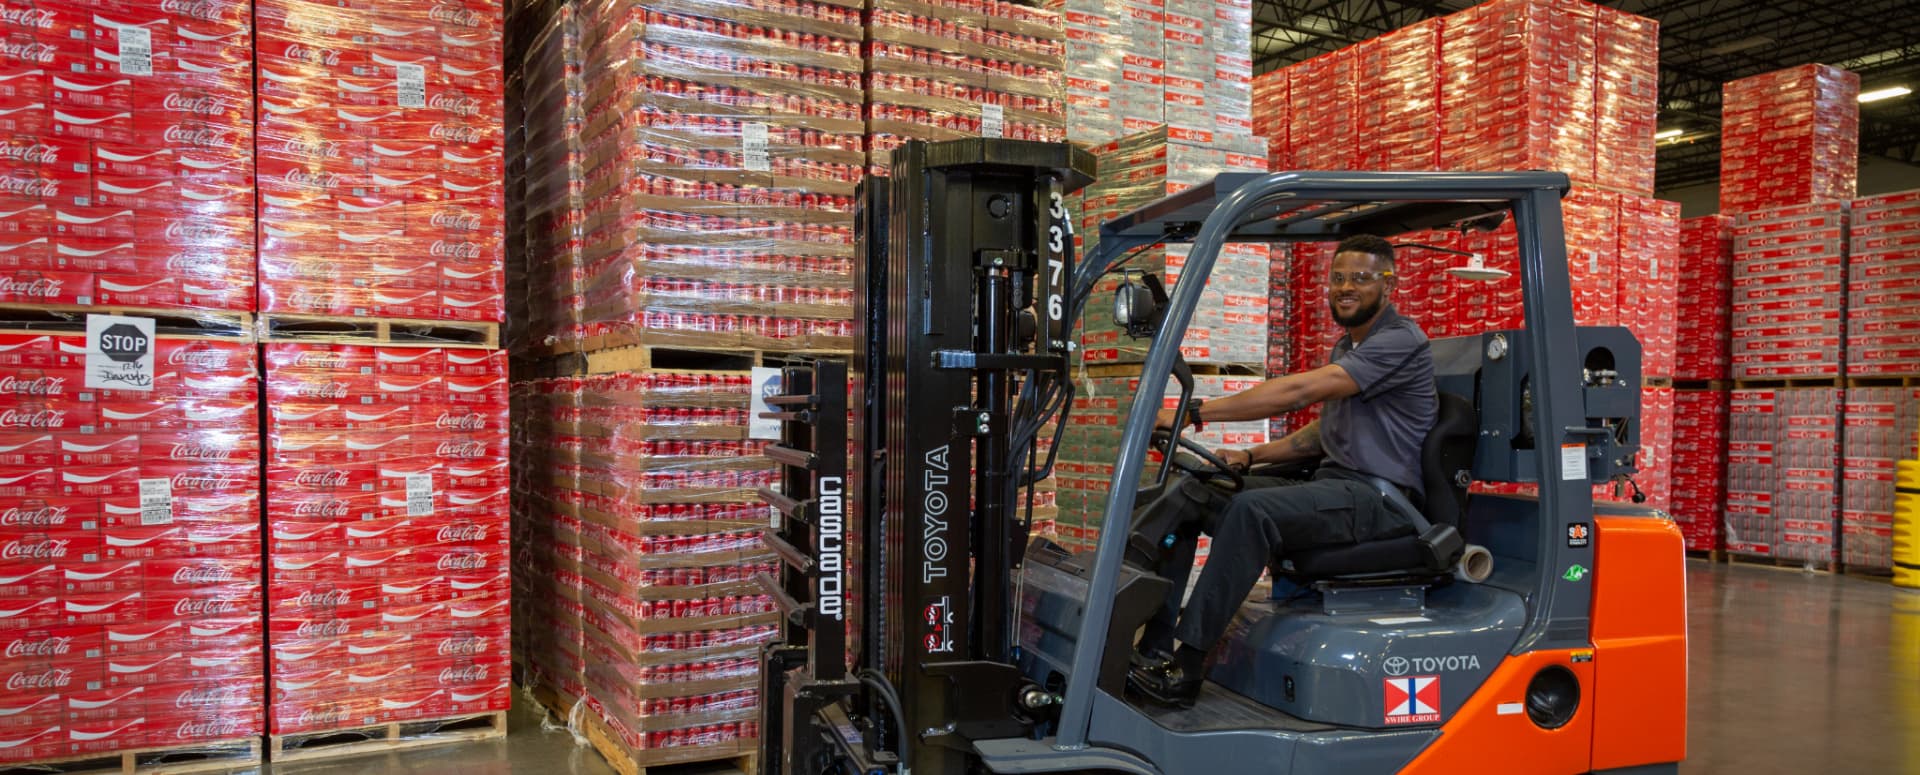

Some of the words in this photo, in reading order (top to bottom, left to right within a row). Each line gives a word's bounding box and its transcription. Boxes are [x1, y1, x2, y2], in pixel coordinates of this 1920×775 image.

[0, 4, 57, 28] oca-Cola
[161, 0, 223, 20] Coca-Cola
[429, 6, 480, 28] Coca-Cola
[0, 40, 58, 62] oca-Cola
[284, 44, 342, 66] Coca-Cola
[164, 92, 225, 115] Coca-Cola
[429, 93, 480, 115] Coca-Cola
[164, 124, 225, 147] Coca-Cola
[430, 124, 480, 143] Coca-Cola
[285, 168, 341, 188] Coca-Cola
[430, 211, 481, 230] Coca-Cola
[430, 240, 481, 259] Coca-Cola
[1048, 191, 1064, 321] 3376
[101, 334, 146, 352] STOP
[294, 352, 350, 369] Coca-Cola
[295, 382, 350, 398] Coca-Cola
[763, 385, 782, 398] ST
[436, 413, 488, 429] Coca-Cola
[170, 443, 232, 460] Coca-Cola
[436, 441, 488, 457] Coca-Cola
[172, 473, 232, 490] Coca-Cola
[295, 470, 350, 486] Coca-Cola
[2, 506, 69, 526] Coca-Cola
[295, 500, 350, 516] Coca-Cola
[923, 444, 950, 584] TOYOTA
[437, 526, 488, 542] Coca-Cola
[1568, 524, 1588, 539] SAS
[2, 539, 70, 559] Coca-Cola
[437, 552, 489, 570] Coca-Cola
[173, 566, 234, 584] Coca-Cola
[174, 597, 235, 616] Coca-Cola
[296, 589, 351, 607] Coca-Cola
[297, 618, 351, 636] Coca-Cola
[6, 637, 74, 658] Coca-Cola
[438, 637, 489, 655] Coca-Cola
[439, 664, 489, 683] Coca-Cola
[1411, 655, 1481, 673] TOYOTA
[7, 669, 74, 690] Coca-Cola
[299, 706, 351, 725] Coca-Cola
[1385, 715, 1410, 724] SWIRE
[1412, 714, 1440, 722] GROUP
[177, 720, 237, 739] Coca-Cola
